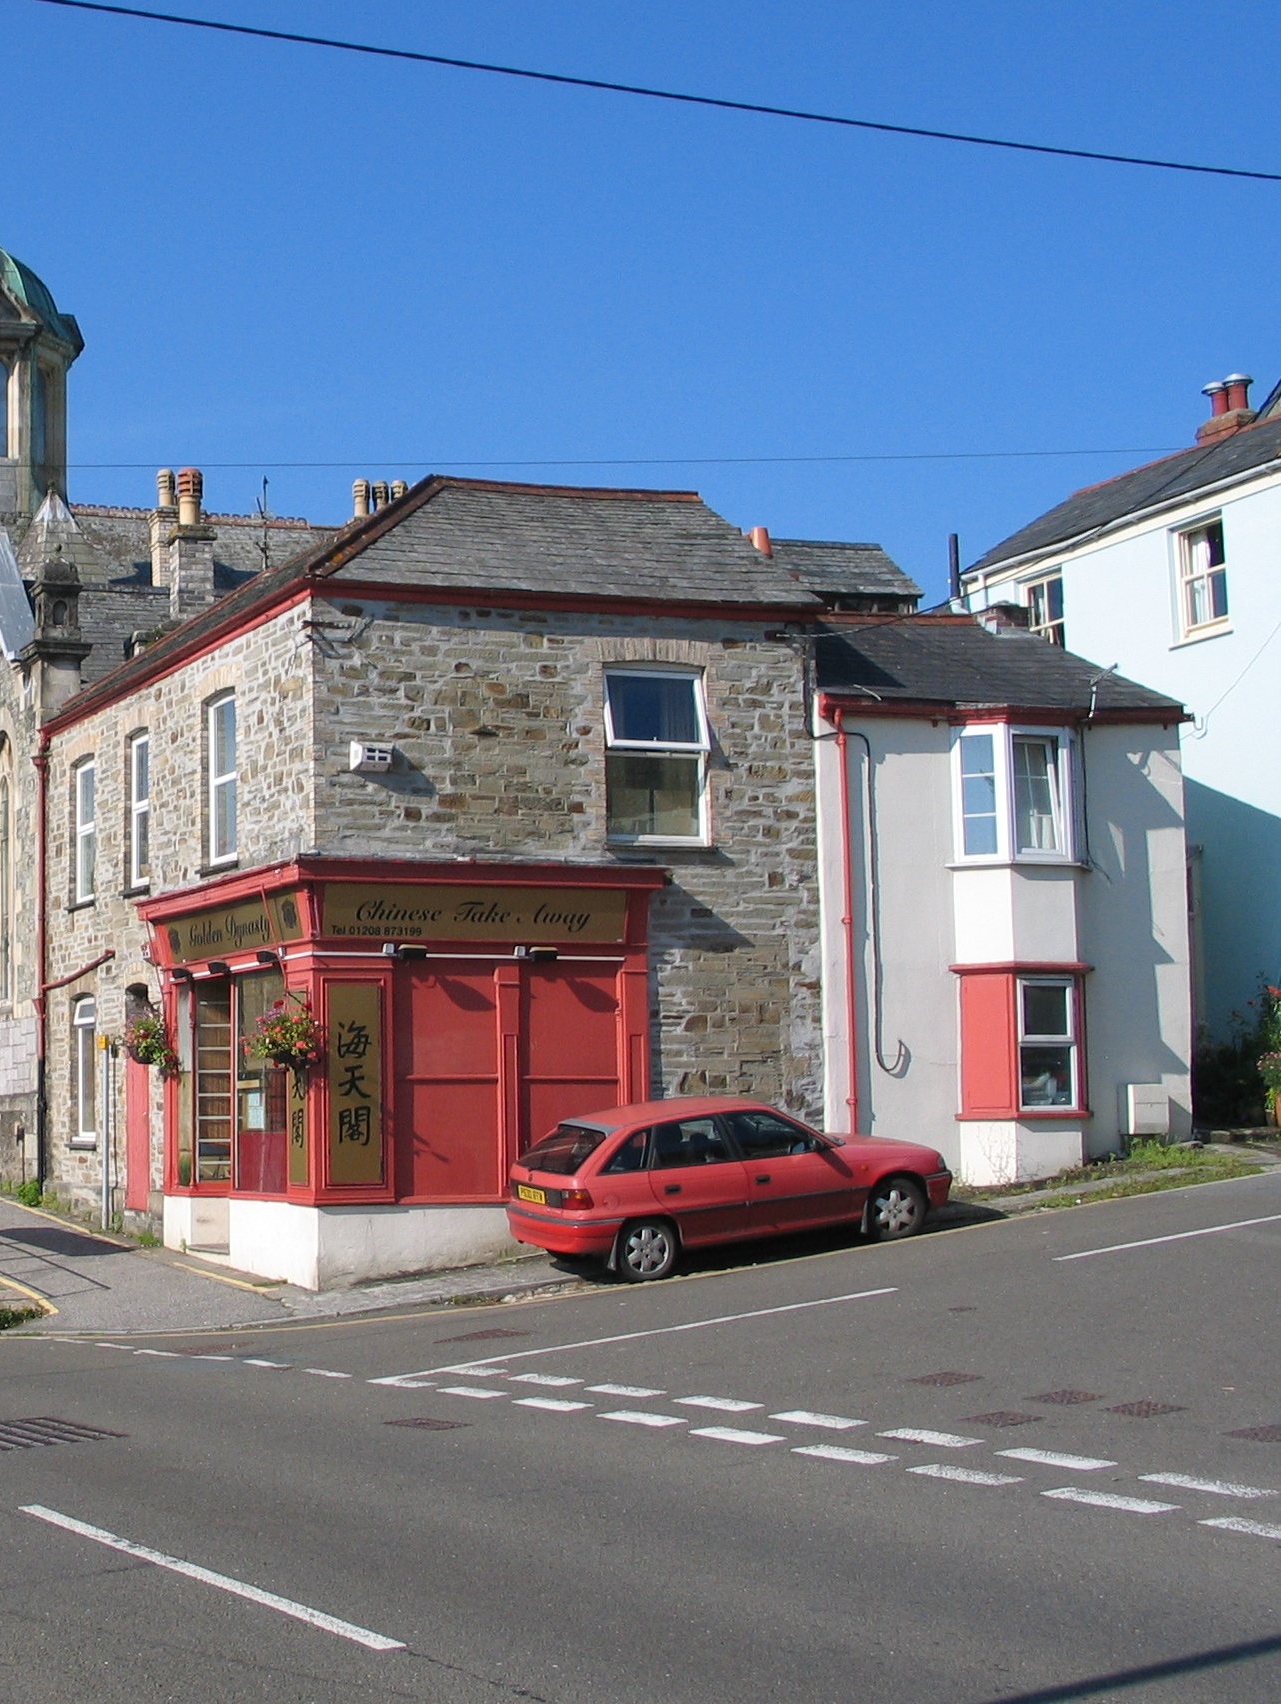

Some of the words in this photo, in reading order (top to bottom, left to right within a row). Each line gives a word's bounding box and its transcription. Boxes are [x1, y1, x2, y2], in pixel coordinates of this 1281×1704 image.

[189, 919, 223, 947] Golden
[224, 914, 271, 949] Dynasty
[331, 924, 347, 936] Tel
[349, 925, 381, 936] 01208
[383, 926, 423, 937] 873199
[355, 900, 443, 922] Chinese
[453, 901, 511, 923] Take
[516, 902, 592, 933] Away
[337, 1020, 372, 1147] 海天閣
